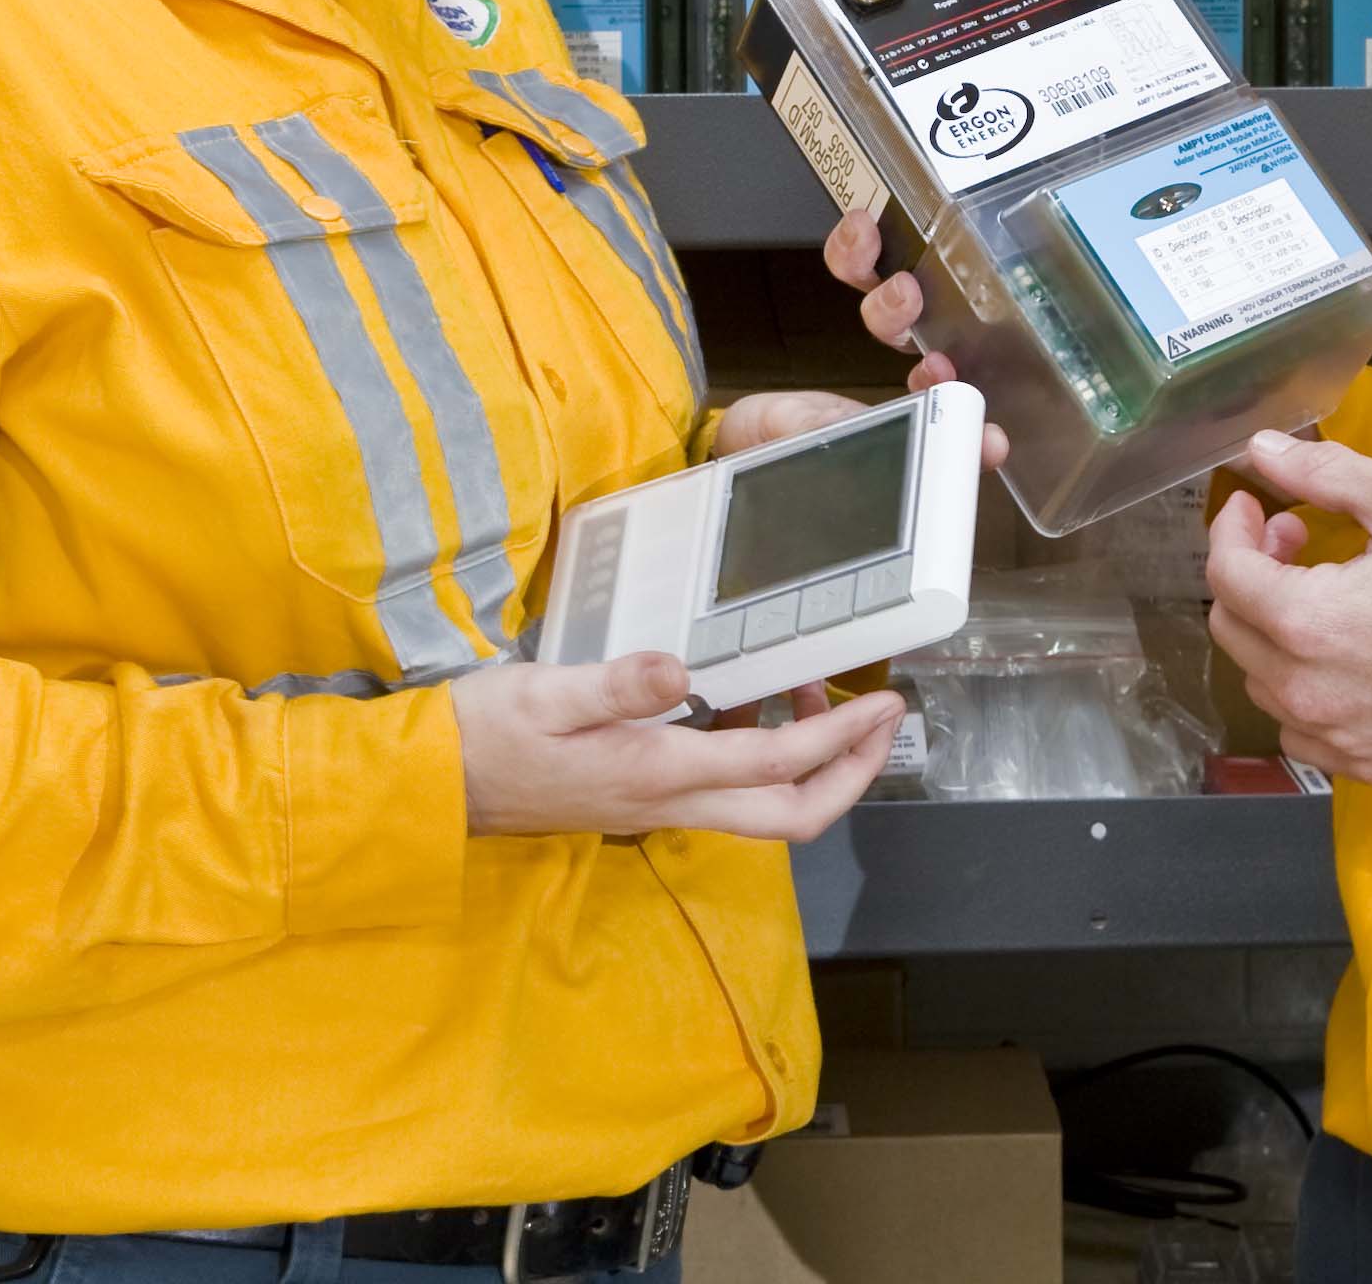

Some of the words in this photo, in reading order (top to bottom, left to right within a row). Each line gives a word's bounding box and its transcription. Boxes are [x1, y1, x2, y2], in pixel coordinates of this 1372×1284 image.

[1038, 65, 1111, 104] 30803109
[788, 104, 802, 130] ID
[949, 105, 1012, 138] ERGON
[958, 118, 1016, 149] ENERGY
[1178, 137, 1204, 155] AMPY
[1205, 124, 1231, 144] Email
[1230, 112, 1272, 134] Metering
[799, 122, 855, 208] PROGRAM
[1173, 154, 1196, 167] Meter
[1196, 144, 1226, 160] Interface
[1227, 133, 1252, 148] Module
[1232, 143, 1251, 155] Type
[1168, 231, 1212, 252] Description
[1232, 203, 1274, 226] Description
[1180, 313, 1234, 342] WARNING
[1256, 290, 1283, 308] UNDER
[1283, 275, 1320, 297] TERMINAL
[1319, 262, 1347, 279] COVER
[1245, 313, 1263, 324] Refer
[1293, 289, 1319, 306] diagram
